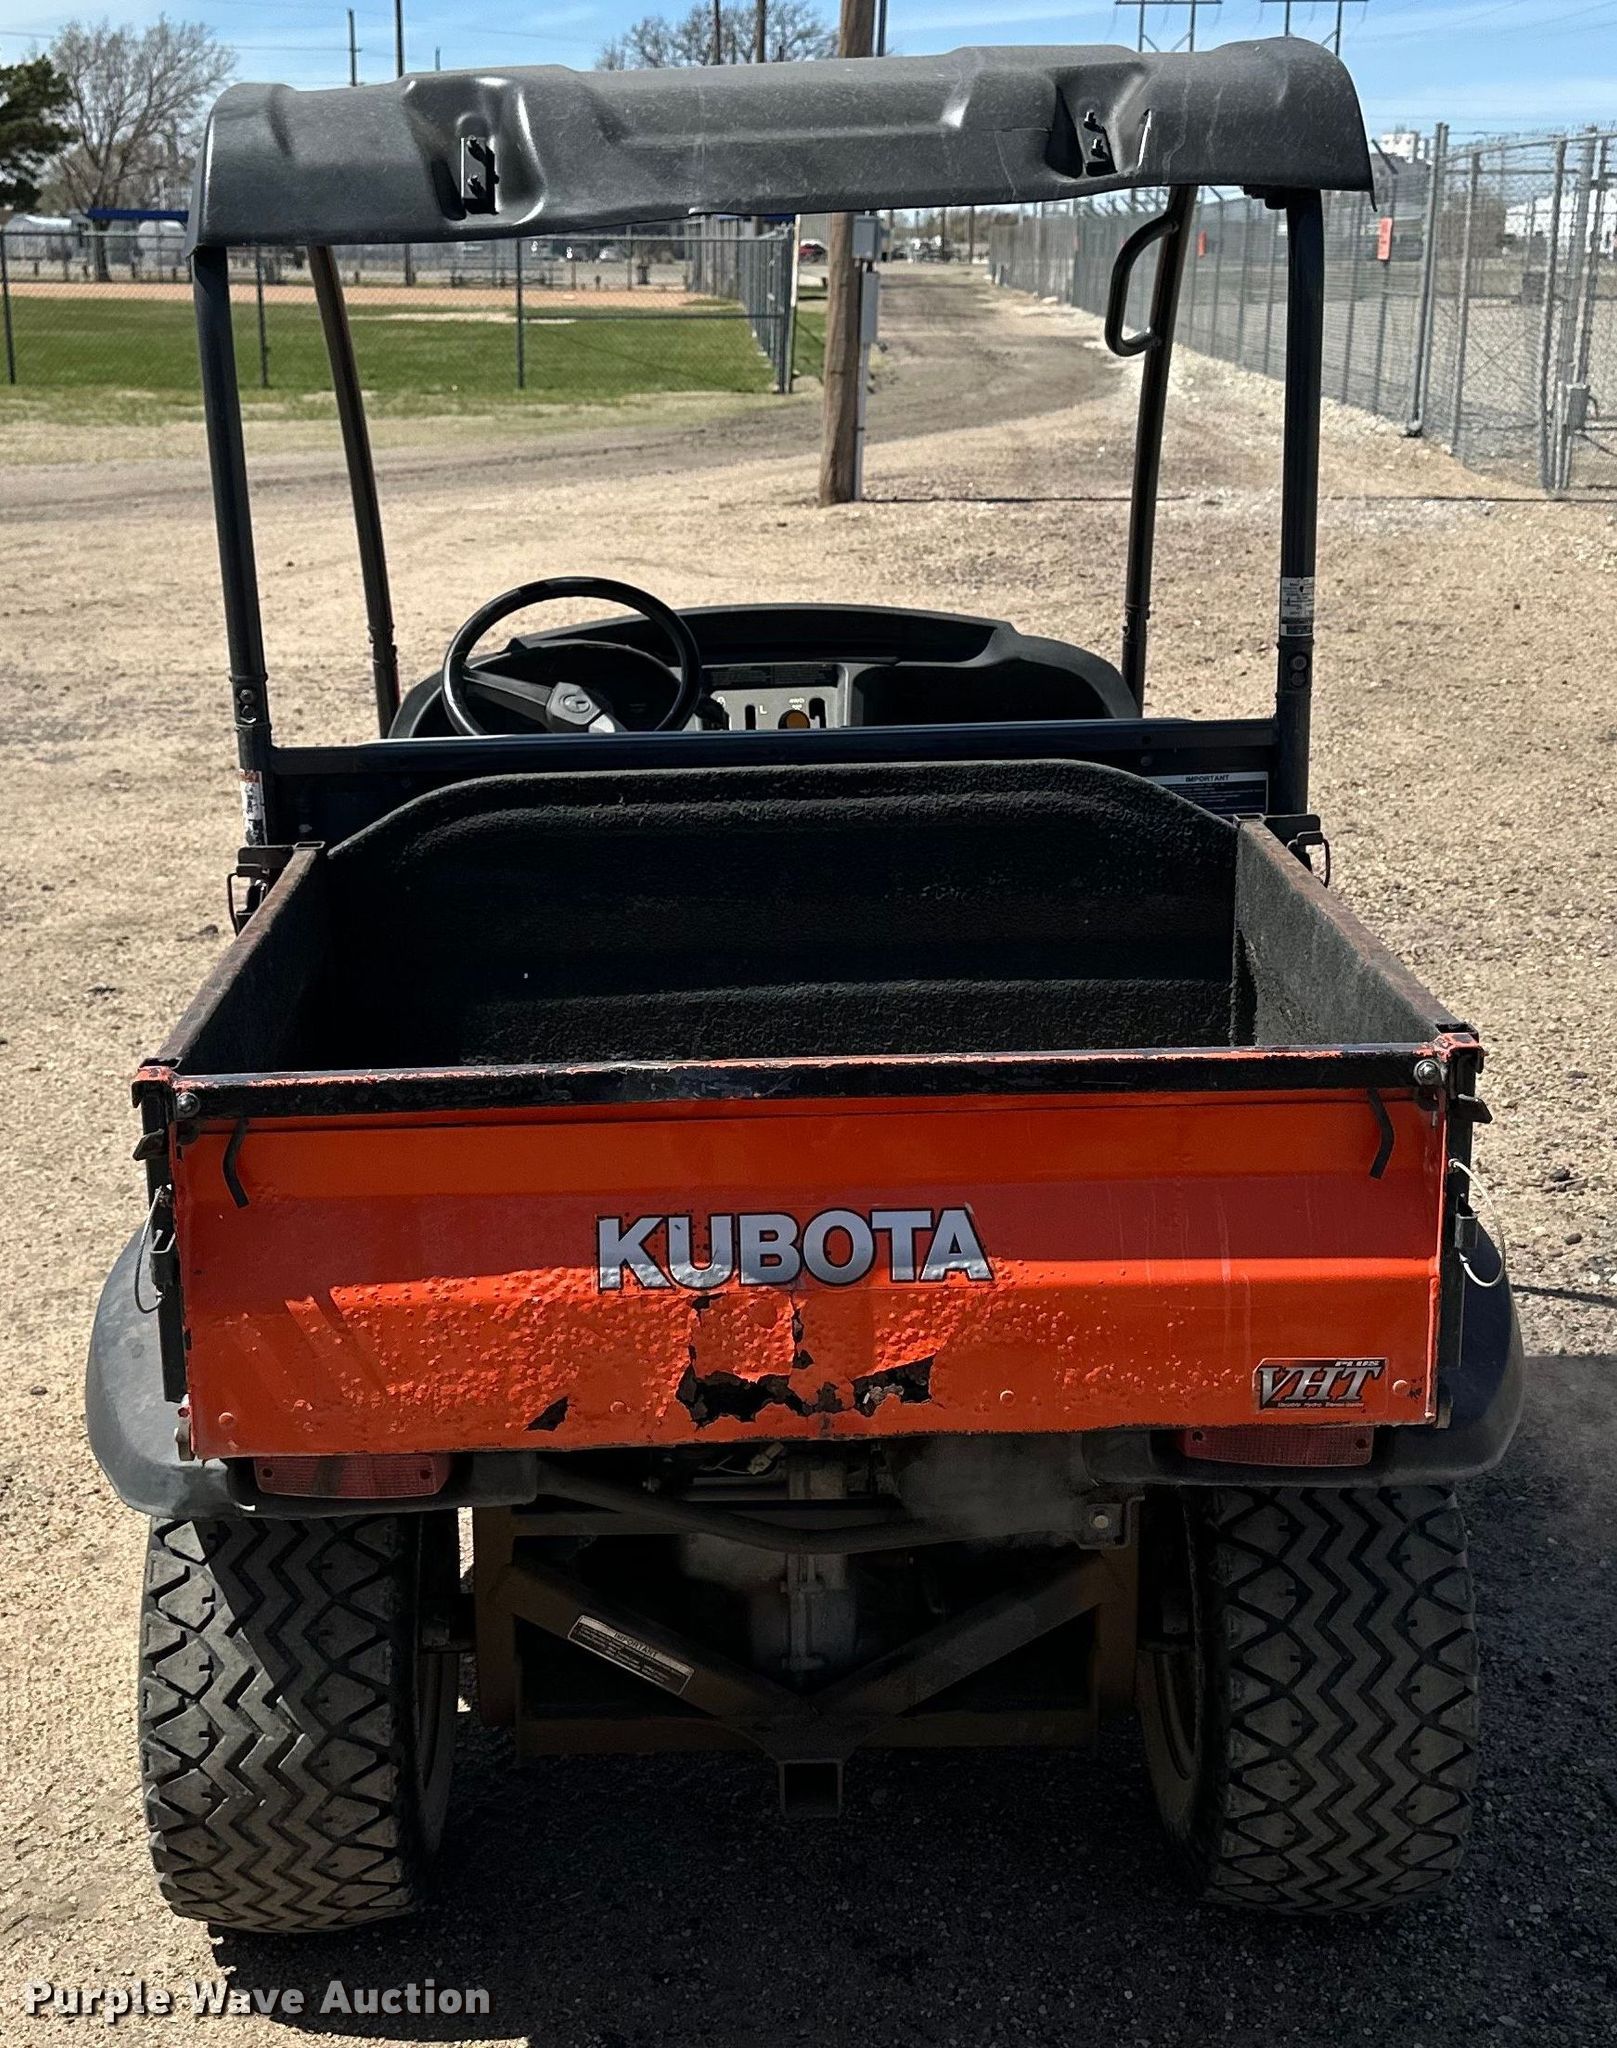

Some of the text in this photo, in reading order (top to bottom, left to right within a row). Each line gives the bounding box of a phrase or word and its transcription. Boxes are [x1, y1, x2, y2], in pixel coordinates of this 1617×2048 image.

[759, 705, 767, 714] L
[1185, 774, 1229, 782] IMPORTANT
[597, 1207, 997, 1293] KUBOTA
[1334, 1360, 1381, 1368] PLUS
[1258, 1366, 1383, 1408] VHT
[614, 1632, 657, 1658] IMPORTANT
